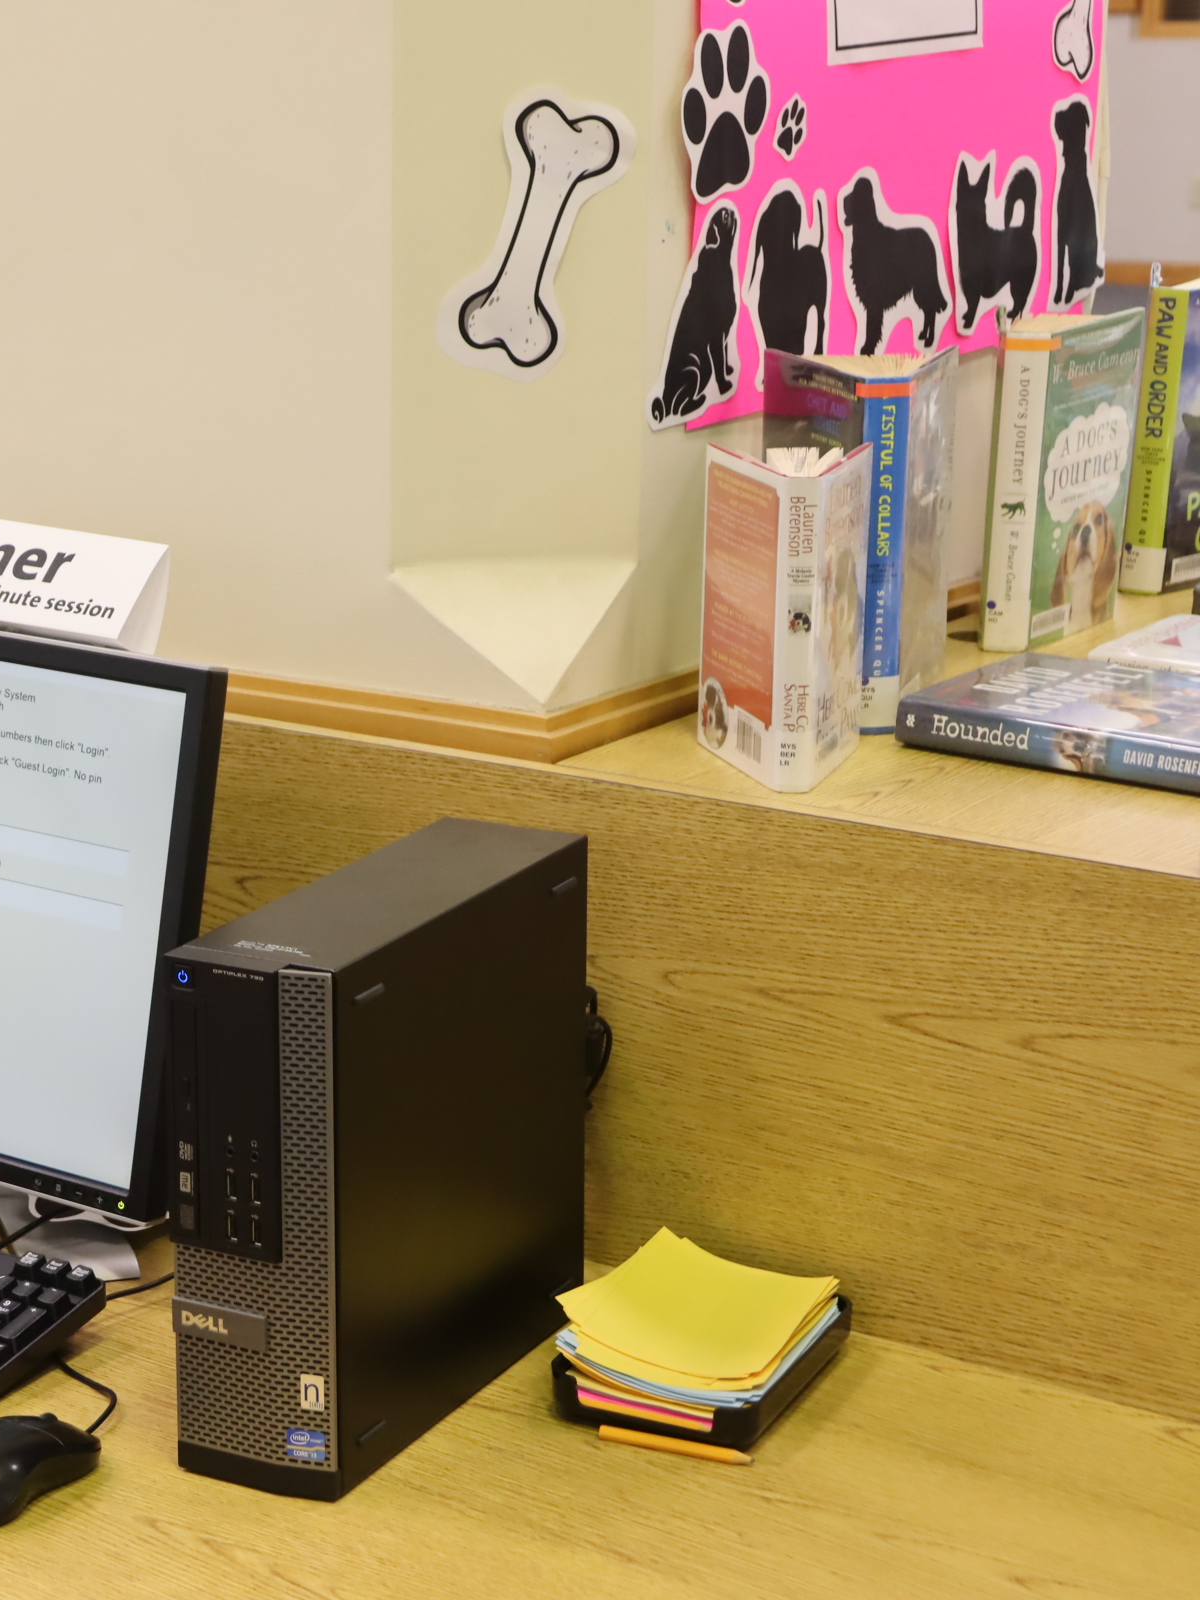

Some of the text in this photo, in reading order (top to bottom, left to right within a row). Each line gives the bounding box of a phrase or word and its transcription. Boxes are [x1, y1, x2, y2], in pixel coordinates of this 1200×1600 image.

[1156, 298, 1176, 339] PAW
[1021, 365, 1030, 374] A
[1068, 358, 1095, 381] Bruce
[1098, 349, 1140, 370] Cameron
[1153, 343, 1168, 376] AND
[1145, 380, 1167, 439] ORDER
[880, 405, 896, 471] FISTFUL
[1061, 434, 1070, 458] A
[879, 475, 893, 491] OF
[788, 496, 806, 557] Berenson
[802, 504, 818, 554] Laurien
[877, 495, 891, 556] COLLARS
[1007, 544, 1017, 570] Bruce
[44, 592, 115, 620] session
[875, 590, 884, 651] SPENCER
[4, 688, 36, 703] System
[34, 734, 53, 747] then
[55, 738, 74, 751] click
[931, 714, 1030, 750] Hounded
[1123, 749, 1153, 768] DAVID
[74, 770, 87, 781] No
[89, 773, 102, 784] pin
[213, 969, 247, 978] OPTIPLEX
[181, 1310, 228, 1335] DELL
[304, 1383, 319, 1402] n
